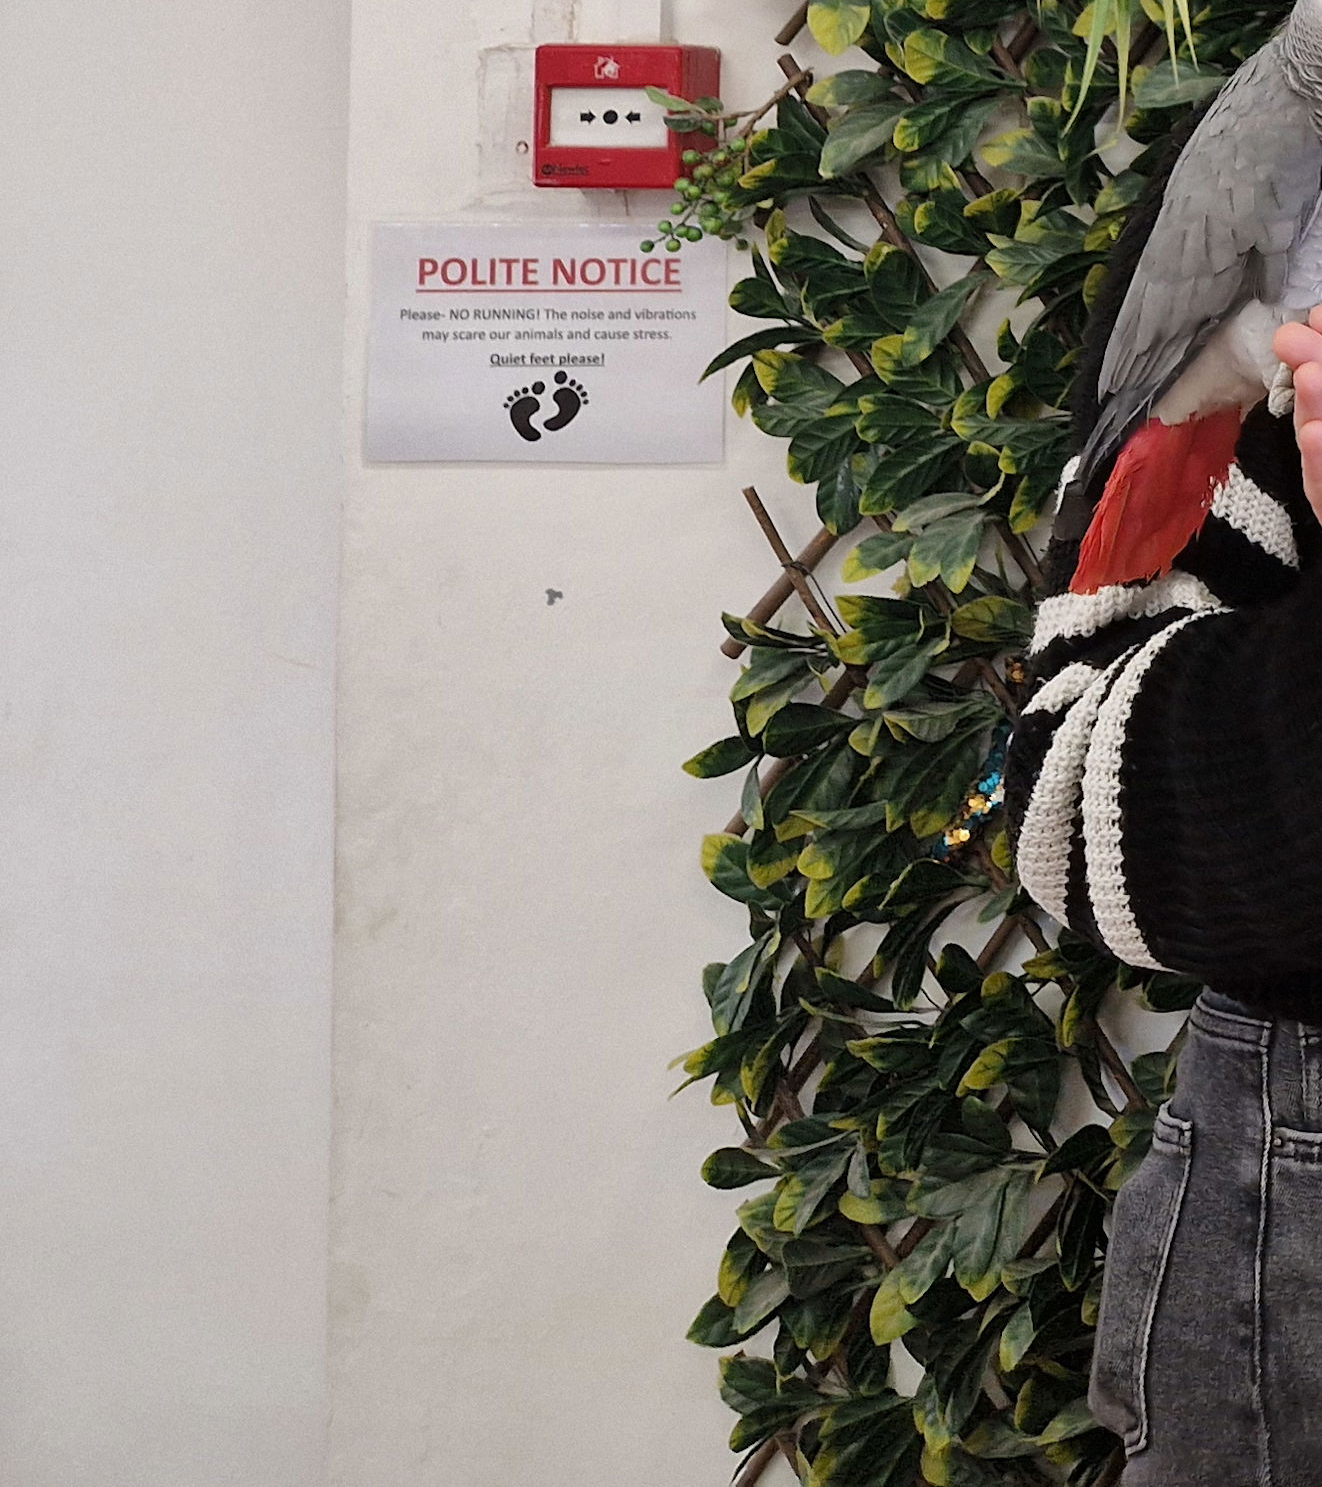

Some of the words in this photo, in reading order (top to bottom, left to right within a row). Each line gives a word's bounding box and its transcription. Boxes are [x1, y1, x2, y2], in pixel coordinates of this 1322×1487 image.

[418, 257, 540, 286] POLITE
[552, 257, 682, 286] NOTICE
[449, 308, 470, 321] NO
[473, 308, 541, 321] RUNNING!
[544, 308, 568, 321] The
[571, 308, 605, 321] noise
[608, 308, 631, 321] and
[635, 308, 697, 321] vibrations
[422, 330, 449, 343] may
[452, 330, 486, 341] scare
[489, 330, 511, 341] our
[514, 328, 563, 341] animals
[567, 328, 591, 341] and
[594, 330, 630, 341] cause
[633, 328, 673, 341] stress.
[490, 353, 526, 367] Quiet
[530, 353, 555, 366] feet
[559, 353, 605, 367] please!
